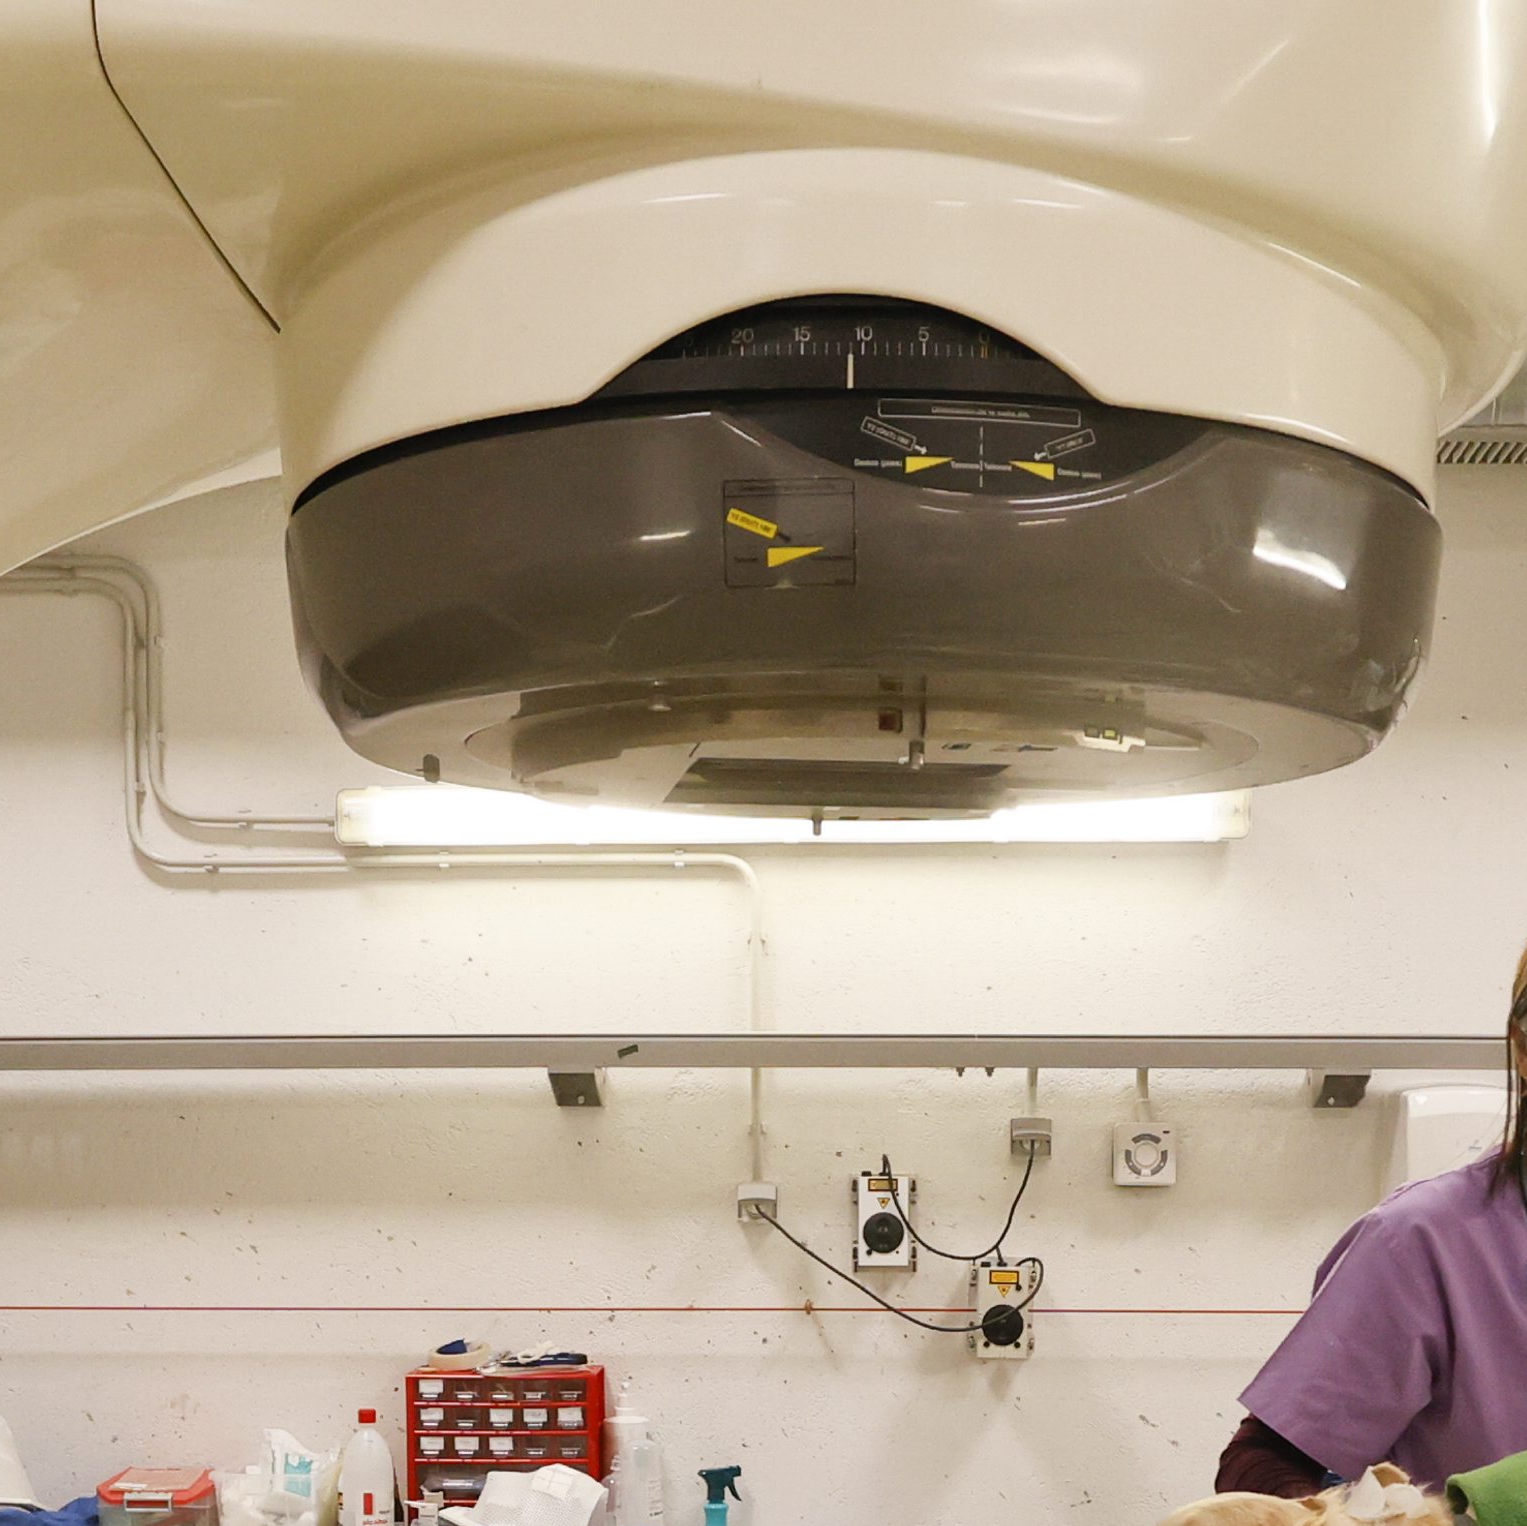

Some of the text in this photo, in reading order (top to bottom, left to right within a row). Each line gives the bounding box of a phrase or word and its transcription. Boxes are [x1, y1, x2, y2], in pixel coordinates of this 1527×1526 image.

[731, 329, 754, 345] 20
[793, 327, 811, 341] 15
[855, 327, 873, 341] 10
[918, 327, 929, 341] 5
